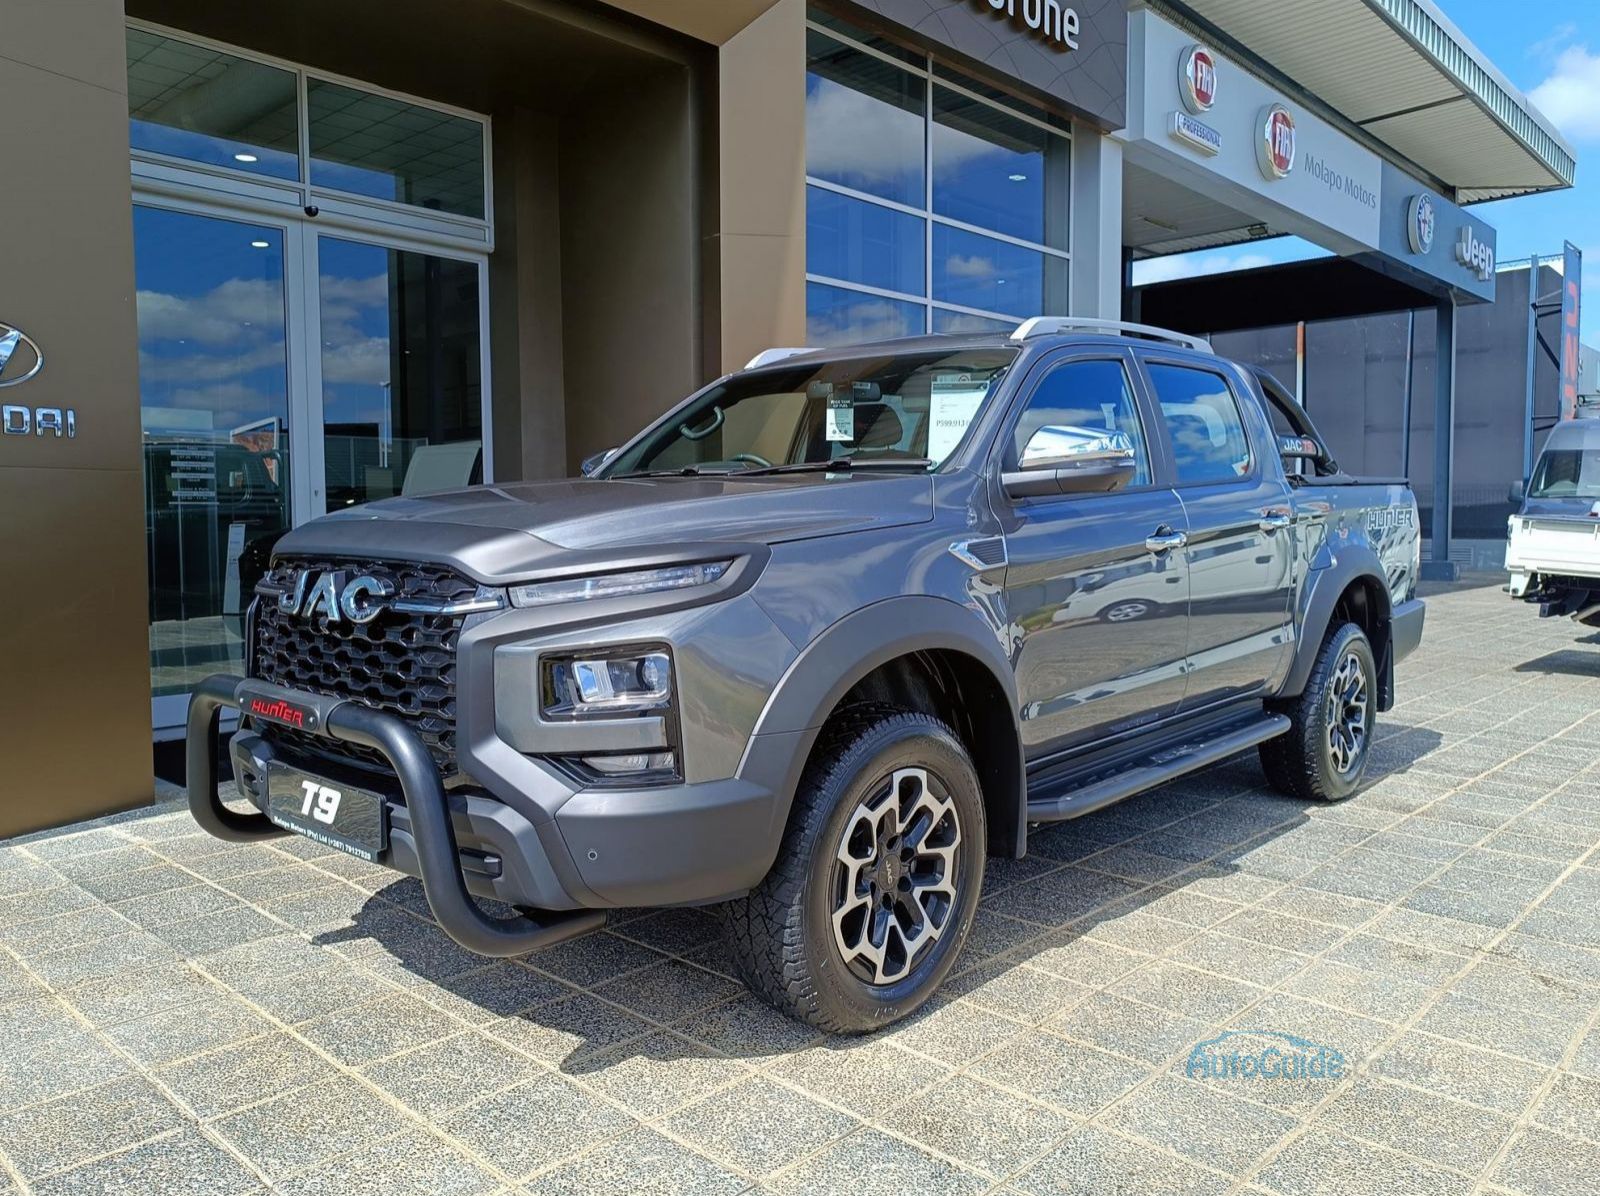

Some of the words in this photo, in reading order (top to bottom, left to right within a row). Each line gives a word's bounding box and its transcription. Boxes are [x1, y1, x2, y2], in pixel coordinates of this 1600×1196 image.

[1182, 116, 1221, 147] PROFESSIONAL
[1304, 153, 1342, 192] Molapo
[1344, 176, 1376, 209] Motors
[1461, 225, 1493, 280] Jeep
[1283, 439, 1302, 451] JAC
[1367, 507, 1414, 530] HUNTER
[279, 570, 388, 624] JAC
[251, 699, 303, 728] HUNTER
[301, 780, 342, 824] T9
[885, 860, 893, 885] JAC
